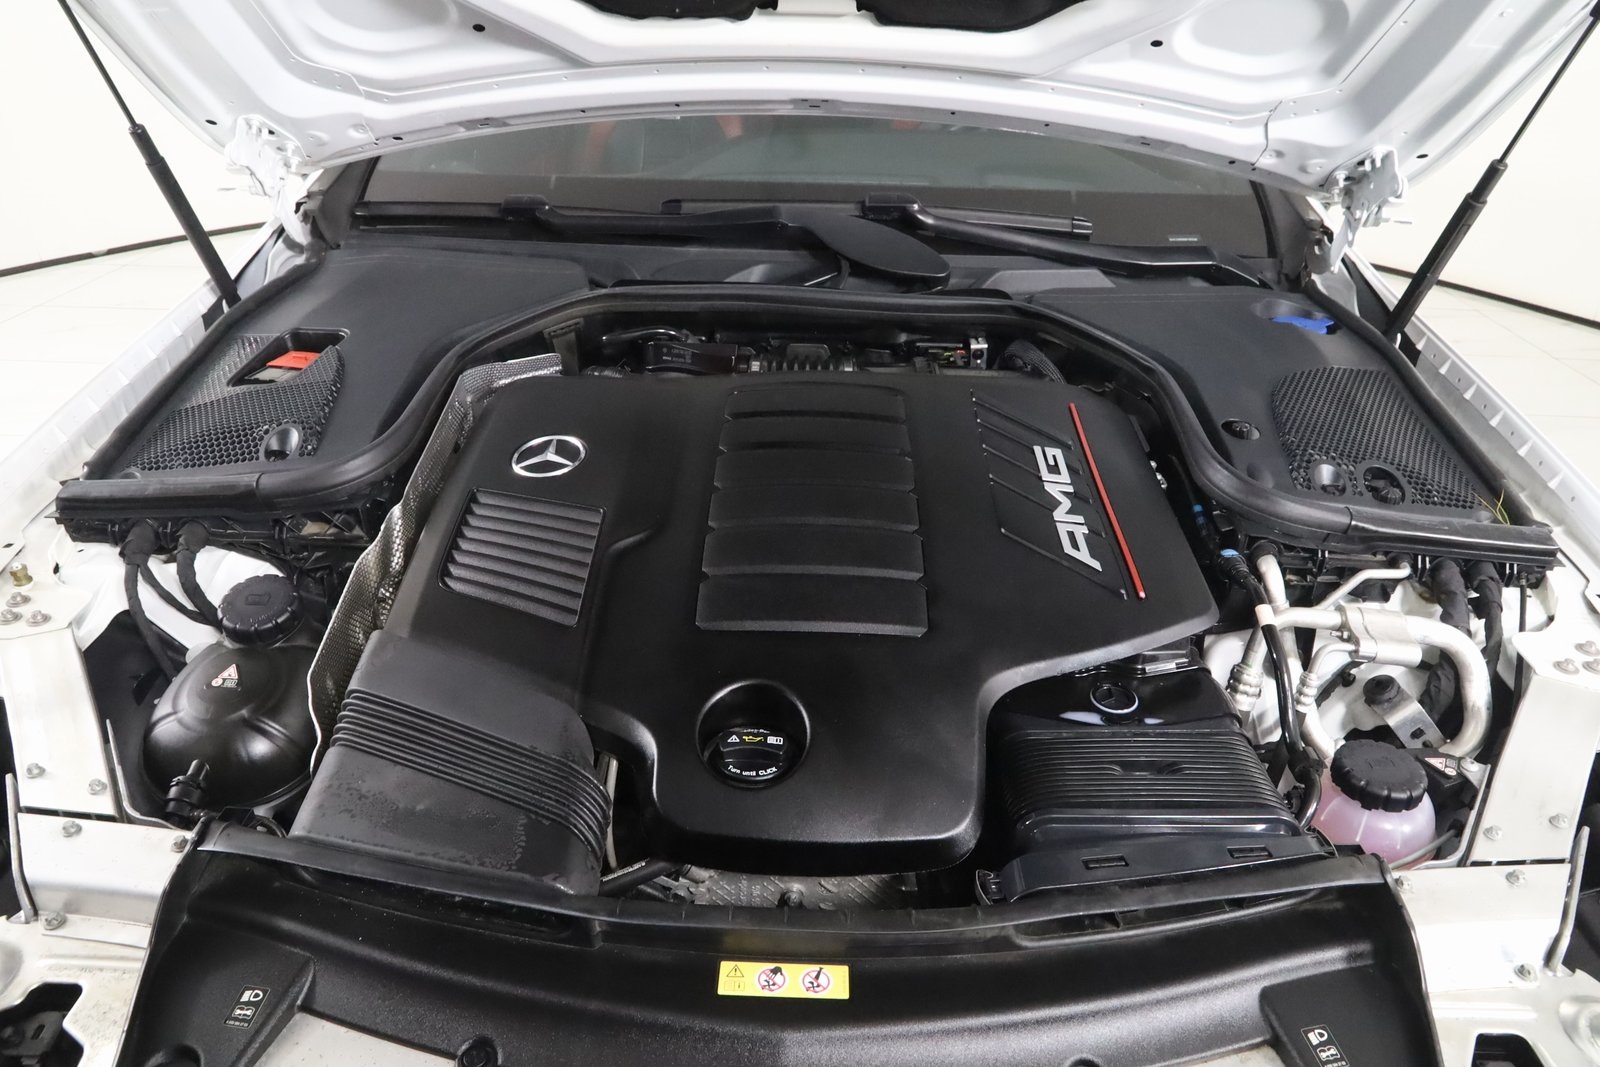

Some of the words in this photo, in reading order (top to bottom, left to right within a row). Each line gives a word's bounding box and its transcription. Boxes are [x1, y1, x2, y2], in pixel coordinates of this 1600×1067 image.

[1033, 445, 1102, 572] AMG
[727, 764, 741, 774] Turn
[758, 766, 778, 776] CLICK
